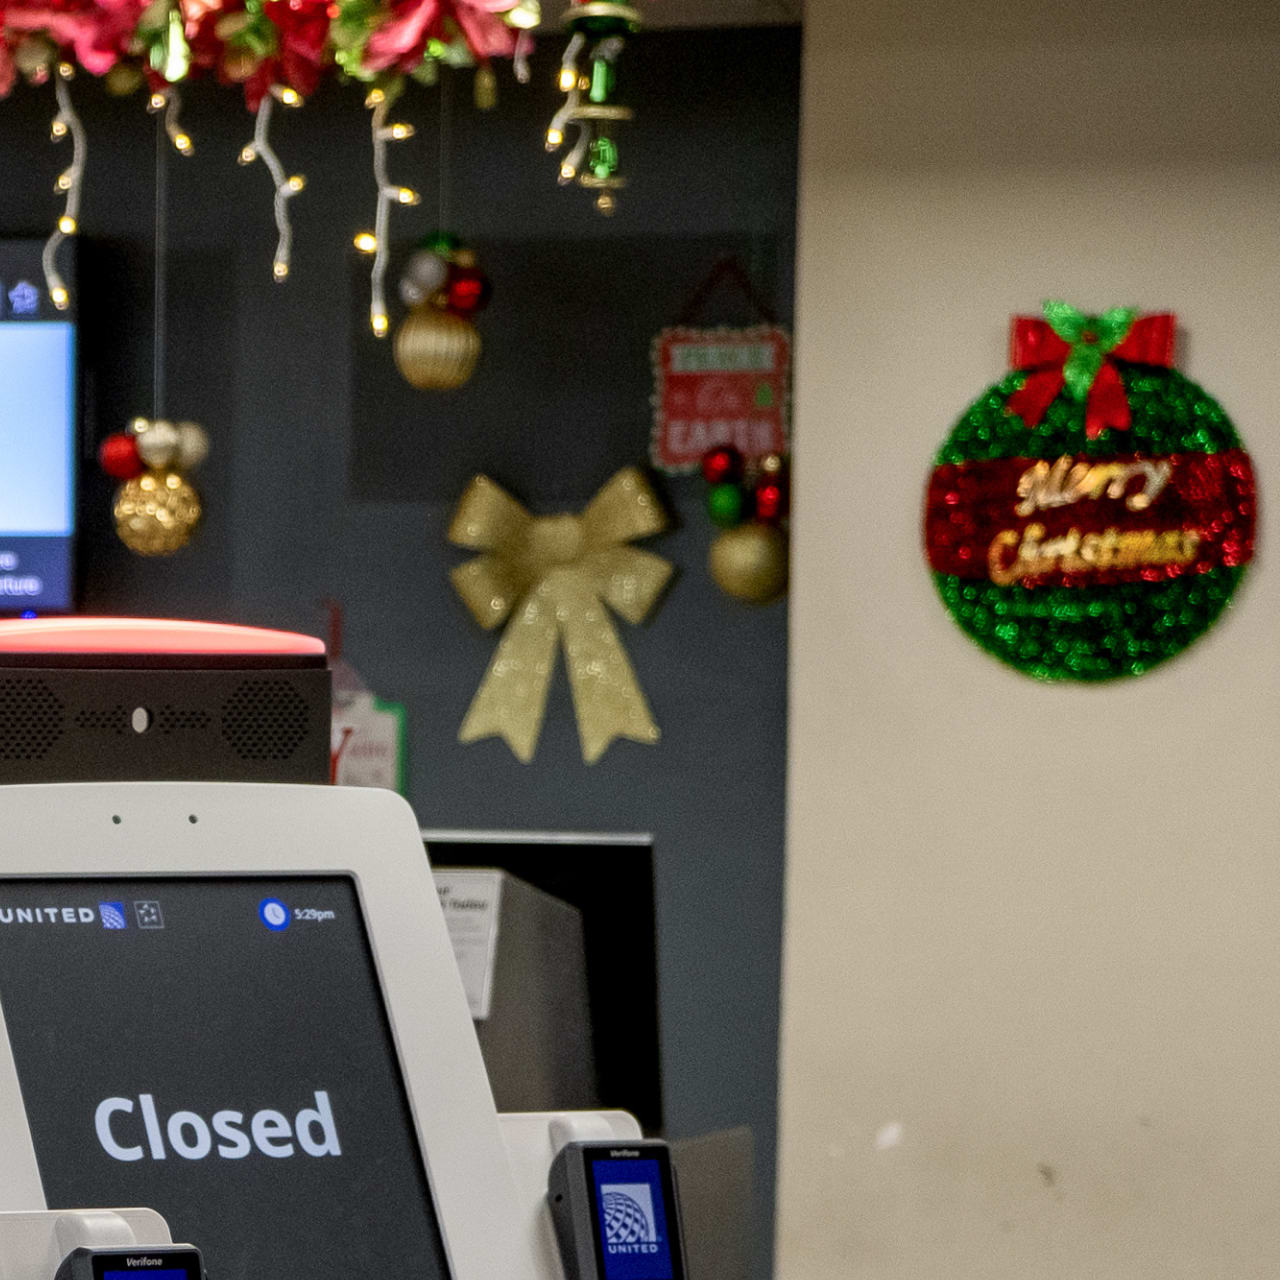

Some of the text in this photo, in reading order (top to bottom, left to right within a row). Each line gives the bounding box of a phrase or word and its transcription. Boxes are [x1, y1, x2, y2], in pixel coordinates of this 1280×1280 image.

[293, 908, 336, 923] 5:29pm
[94, 1090, 342, 1162] Closed
[607, 1243, 659, 1255] UNITED
[126, 1256, 163, 1267] Verifone
